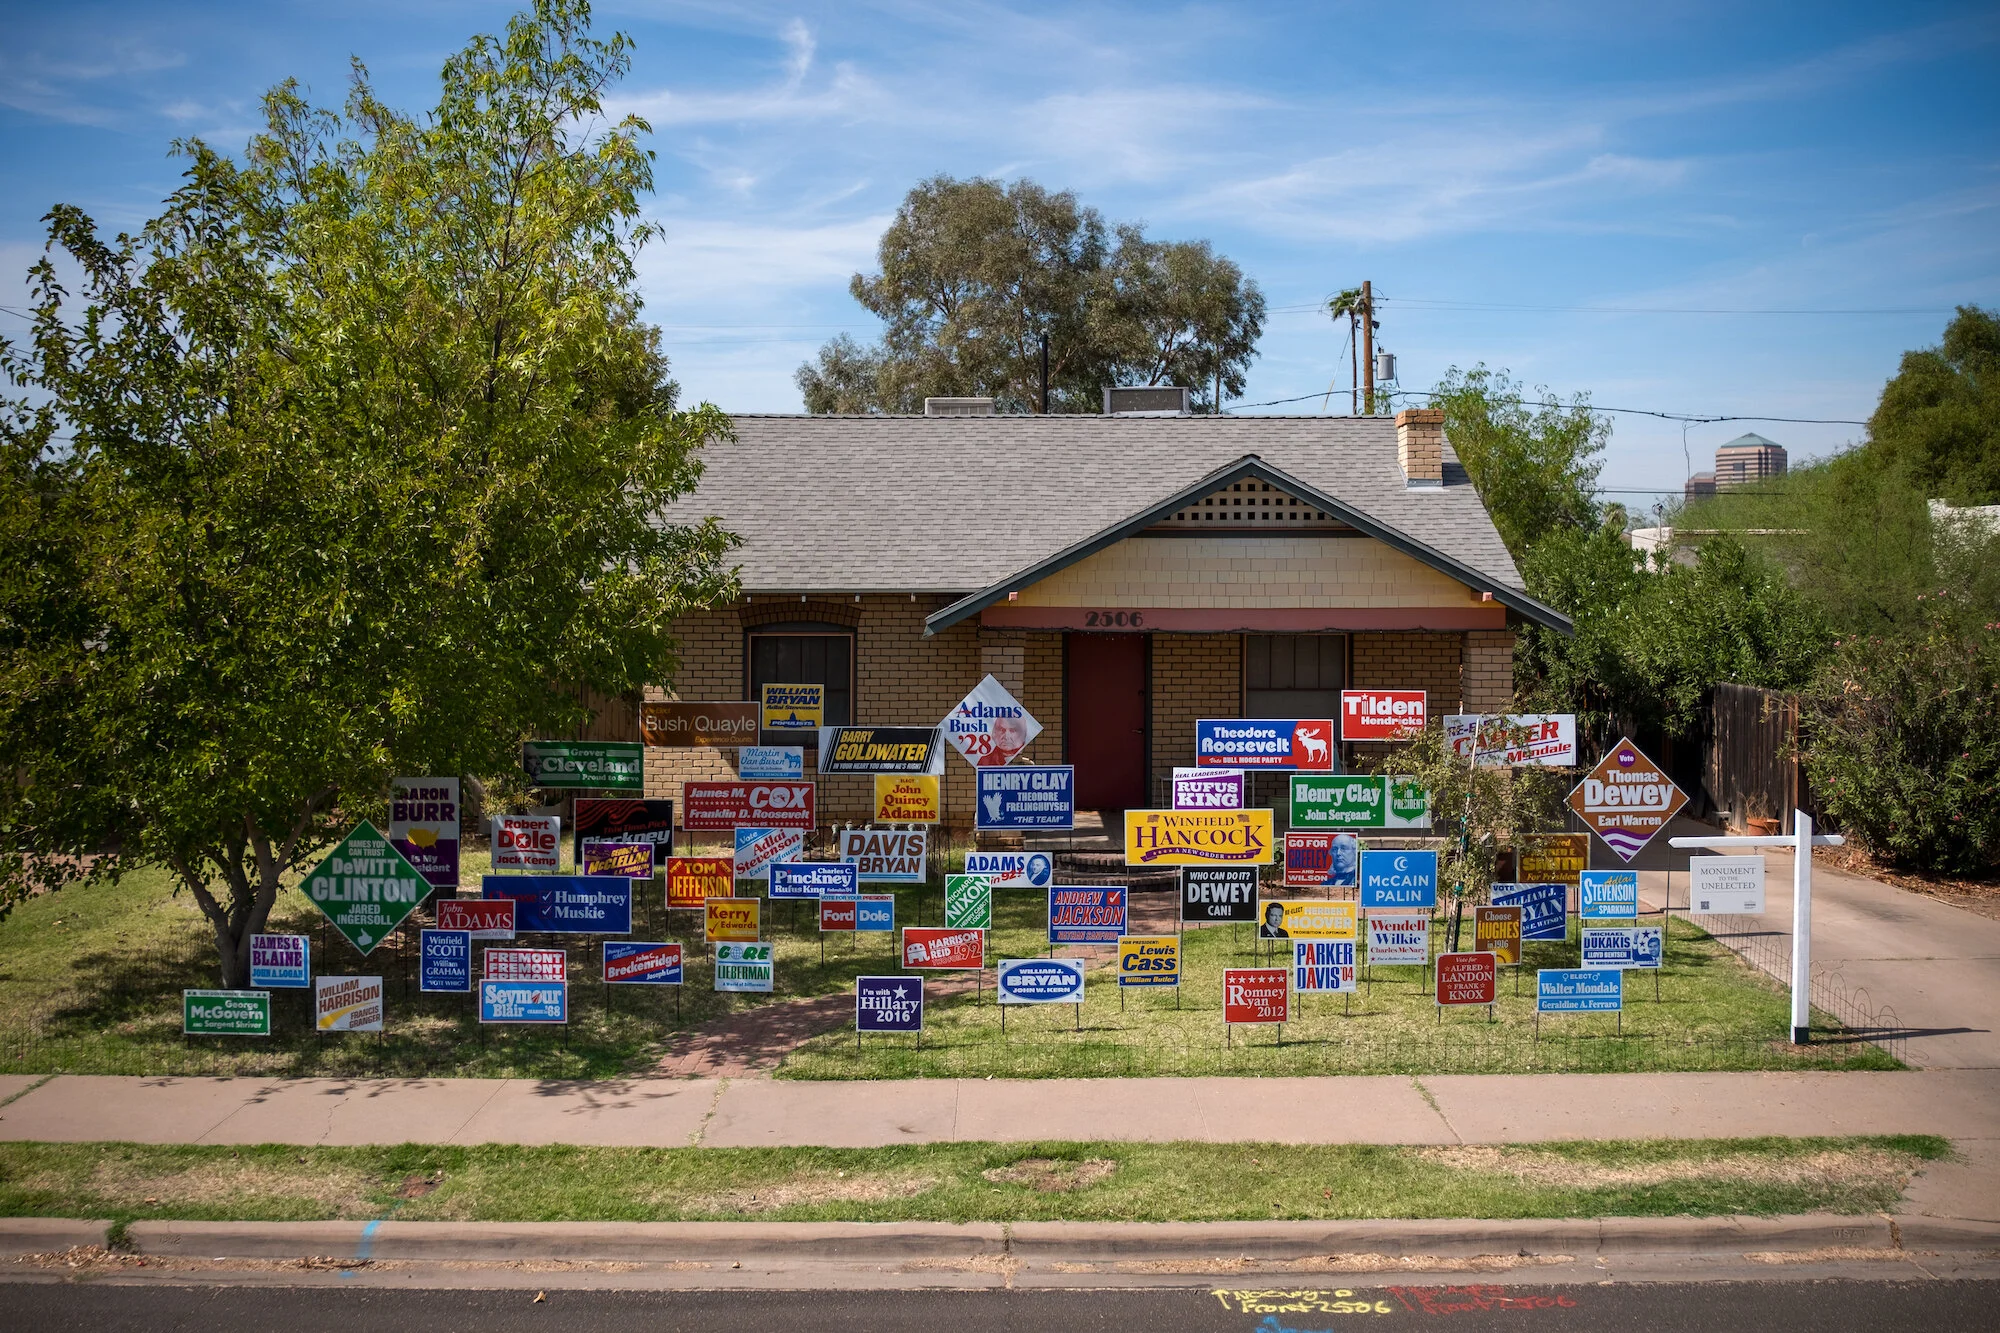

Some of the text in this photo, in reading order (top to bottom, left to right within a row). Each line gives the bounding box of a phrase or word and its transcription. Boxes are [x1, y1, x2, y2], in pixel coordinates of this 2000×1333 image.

[1085, 611, 1144, 627] 2506
[766, 696, 820, 705] BRYAN
[1343, 694, 1424, 715] Tilden
[957, 701, 1022, 718] Adams
[646, 715, 756, 735] Bush/Quayle
[950, 719, 988, 733] Bush
[1361, 716, 1423, 725] Hendricks
[839, 730, 875, 743] BARRY
[1213, 727, 1276, 738] Theodore
[958, 734, 992, 755] '28
[1201, 738, 1289, 753] Roosevelt
[746, 748, 780, 757] Martin
[835, 743, 928, 762] GOLDWATER
[1619, 754, 1634, 762] Vote
[542, 757, 640, 774] Cleveland
[840, 762, 853, 770] YOUR
[853, 762, 869, 770] HEART
[983, 773, 1070, 791] HENRY CLAY
[1606, 770, 1659, 783] Thomas
[893, 785, 921, 795] John
[1177, 781, 1239, 793] RUFUS
[749, 786, 811, 808] COX
[884, 795, 930, 806] Quincy
[1177, 792, 1239, 807] KING
[1295, 783, 1381, 807] Henry Clay
[1584, 780, 1675, 811] Dewey
[393, 803, 455, 822] BURR
[878, 806, 936, 819] Adams
[504, 819, 549, 830] Robert
[1163, 815, 1235, 827] WINFIELD
[1598, 815, 1662, 827] Earl Warren
[498, 830, 556, 849] Dole
[1134, 825, 1265, 848] HANCOCK
[1288, 839, 1328, 848] GO FOR
[349, 840, 385, 849] NAMES YOU
[847, 834, 923, 856] DAVIS
[497, 855, 556, 867] Jack Kemp
[736, 833, 800, 875] Stevenson
[1199, 850, 1225, 860] ORDER
[1288, 849, 1329, 869] GREELEY
[332, 858, 399, 875] DeWITT
[587, 850, 651, 875] McCLELLAN
[684, 863, 716, 874] TOM
[858, 857, 921, 873] BRYAN
[967, 856, 1025, 871] ADAMS
[1522, 856, 1584, 871] SMITH
[774, 869, 853, 887] Pinckney
[1190, 871, 1250, 880] WHO CAN DO IT?
[1287, 874, 1328, 882] WILSON
[1700, 867, 1756, 875] MONUMENT
[669, 876, 731, 898] JEFFERSON
[1369, 875, 1429, 887] McCAIN
[1701, 882, 1756, 890] UNELECTED
[311, 877, 416, 903] CLINTON
[775, 885, 825, 894] Rufus King
[948, 876, 975, 904] RICHARD
[1187, 883, 1253, 903] DEWEY
[1375, 890, 1422, 902] PALIN
[1584, 878, 1635, 905] STEVENSON
[555, 890, 627, 906] Humphrey
[947, 876, 990, 921] NIXON
[1054, 891, 1103, 905] ANDREW
[349, 904, 380, 914] JARED
[442, 903, 463, 913] John
[555, 905, 605, 919] Muskie
[708, 906, 750, 922] Kerry
[823, 909, 855, 921] Ford
[960, 900, 989, 929] HENRY CABOT
[1207, 905, 1232, 916] CAN!
[337, 914, 393, 925] INGERSOLL
[440, 913, 513, 929] ADAMS
[859, 909, 891, 922] Dole
[969, 909, 987, 925] LODGE
[1052, 906, 1125, 926] JACKSON
[1287, 916, 1353, 929] HOOVER
[1485, 911, 1512, 921] Choose
[720, 921, 757, 929] Edwards
[1370, 919, 1426, 931] Wendell
[1477, 920, 1519, 939] HUGHES
[252, 936, 302, 950] JAMES G.
[430, 936, 462, 945] Winfield
[928, 931, 979, 949] HARRISON
[1375, 933, 1421, 945] Wilkie
[1487, 940, 1508, 949] in 1916
[1584, 937, 1631, 949] DUKAKIS
[427, 945, 466, 957] SCOTT
[718, 945, 770, 960] GORE
[930, 947, 951, 959] REID
[1139, 945, 1175, 955] Lewis
[1297, 943, 1353, 966] PARKER
[252, 951, 302, 967] BLAINE
[489, 953, 562, 963] FREMONT
[1122, 953, 1176, 971] Cass
[427, 968, 465, 976] GRAHAM
[489, 963, 562, 974] FREMONT
[607, 953, 679, 979] Breckenridge
[718, 966, 770, 980] LIEBERMAN
[1451, 964, 1483, 972] ALFRED
[1007, 975, 1077, 986] BRYAN
[1297, 966, 1340, 989] DAVIS
[1441, 972, 1493, 983] LANDON
[319, 979, 360, 998] WILLIAM
[485, 985, 562, 1006] Seymour
[1227, 985, 1285, 1005] Romney
[1449, 990, 1484, 1001] KNOX
[1541, 982, 1618, 995] Walter Mondale
[224, 1000, 259, 1010] George
[319, 984, 380, 1014] HARRISON
[860, 997, 920, 1014] Hillary
[190, 1005, 264, 1019] McGovern
[350, 1005, 379, 1019] FRANCIS
[493, 1005, 525, 1017] Blair
[876, 1011, 911, 1023] 2016
[1257, 1006, 1285, 1017] 2012
[349, 1013, 381, 1028] GRANGER
[1315, 1300, 1391, 1314] 2506
